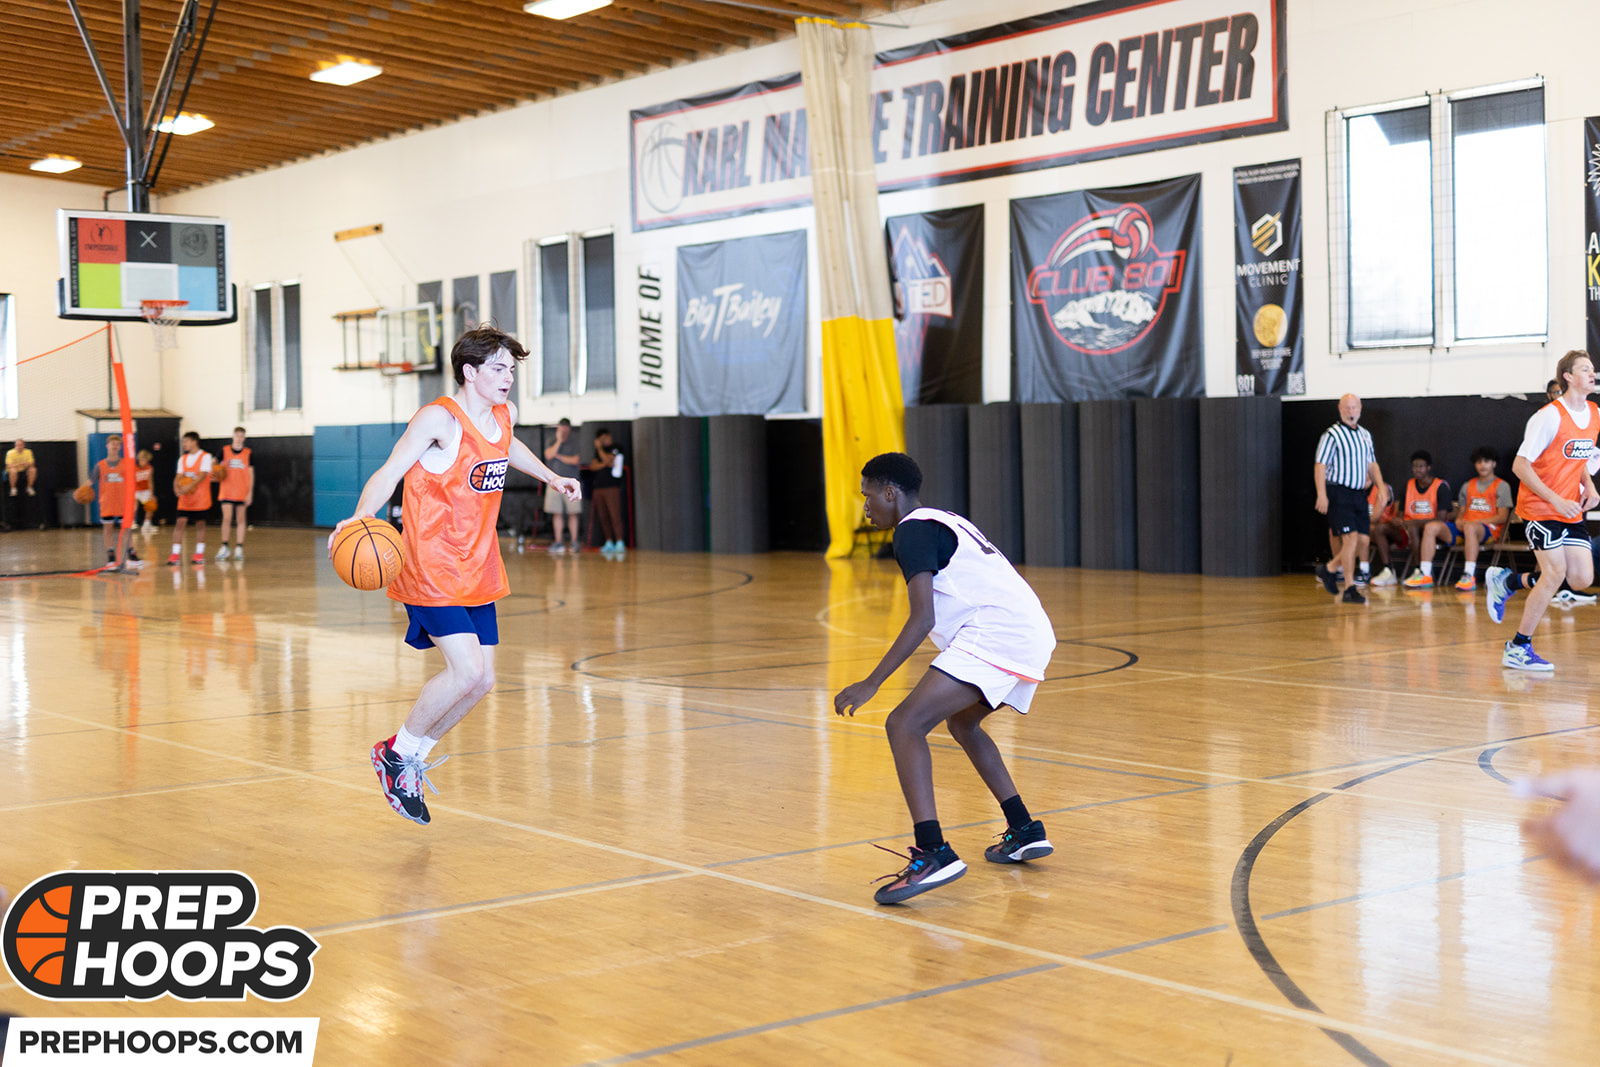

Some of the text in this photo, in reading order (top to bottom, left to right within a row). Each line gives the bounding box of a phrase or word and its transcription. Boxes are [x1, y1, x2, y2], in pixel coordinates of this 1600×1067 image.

[682, 12, 1259, 197] KARL MAE TRAINING CENTER
[1588, 231, 1600, 254] A
[1237, 258, 1300, 277] MOVEMENT
[1588, 254, 1600, 287] K
[1032, 265, 1115, 297] CLUB
[1248, 273, 1289, 288] CLINIC
[1588, 286, 1600, 301] TH
[638, 264, 663, 389] HOME OF
[1237, 374, 1255, 392] 801
[486, 461, 508, 476] PRE
[482, 474, 505, 489] HOO
